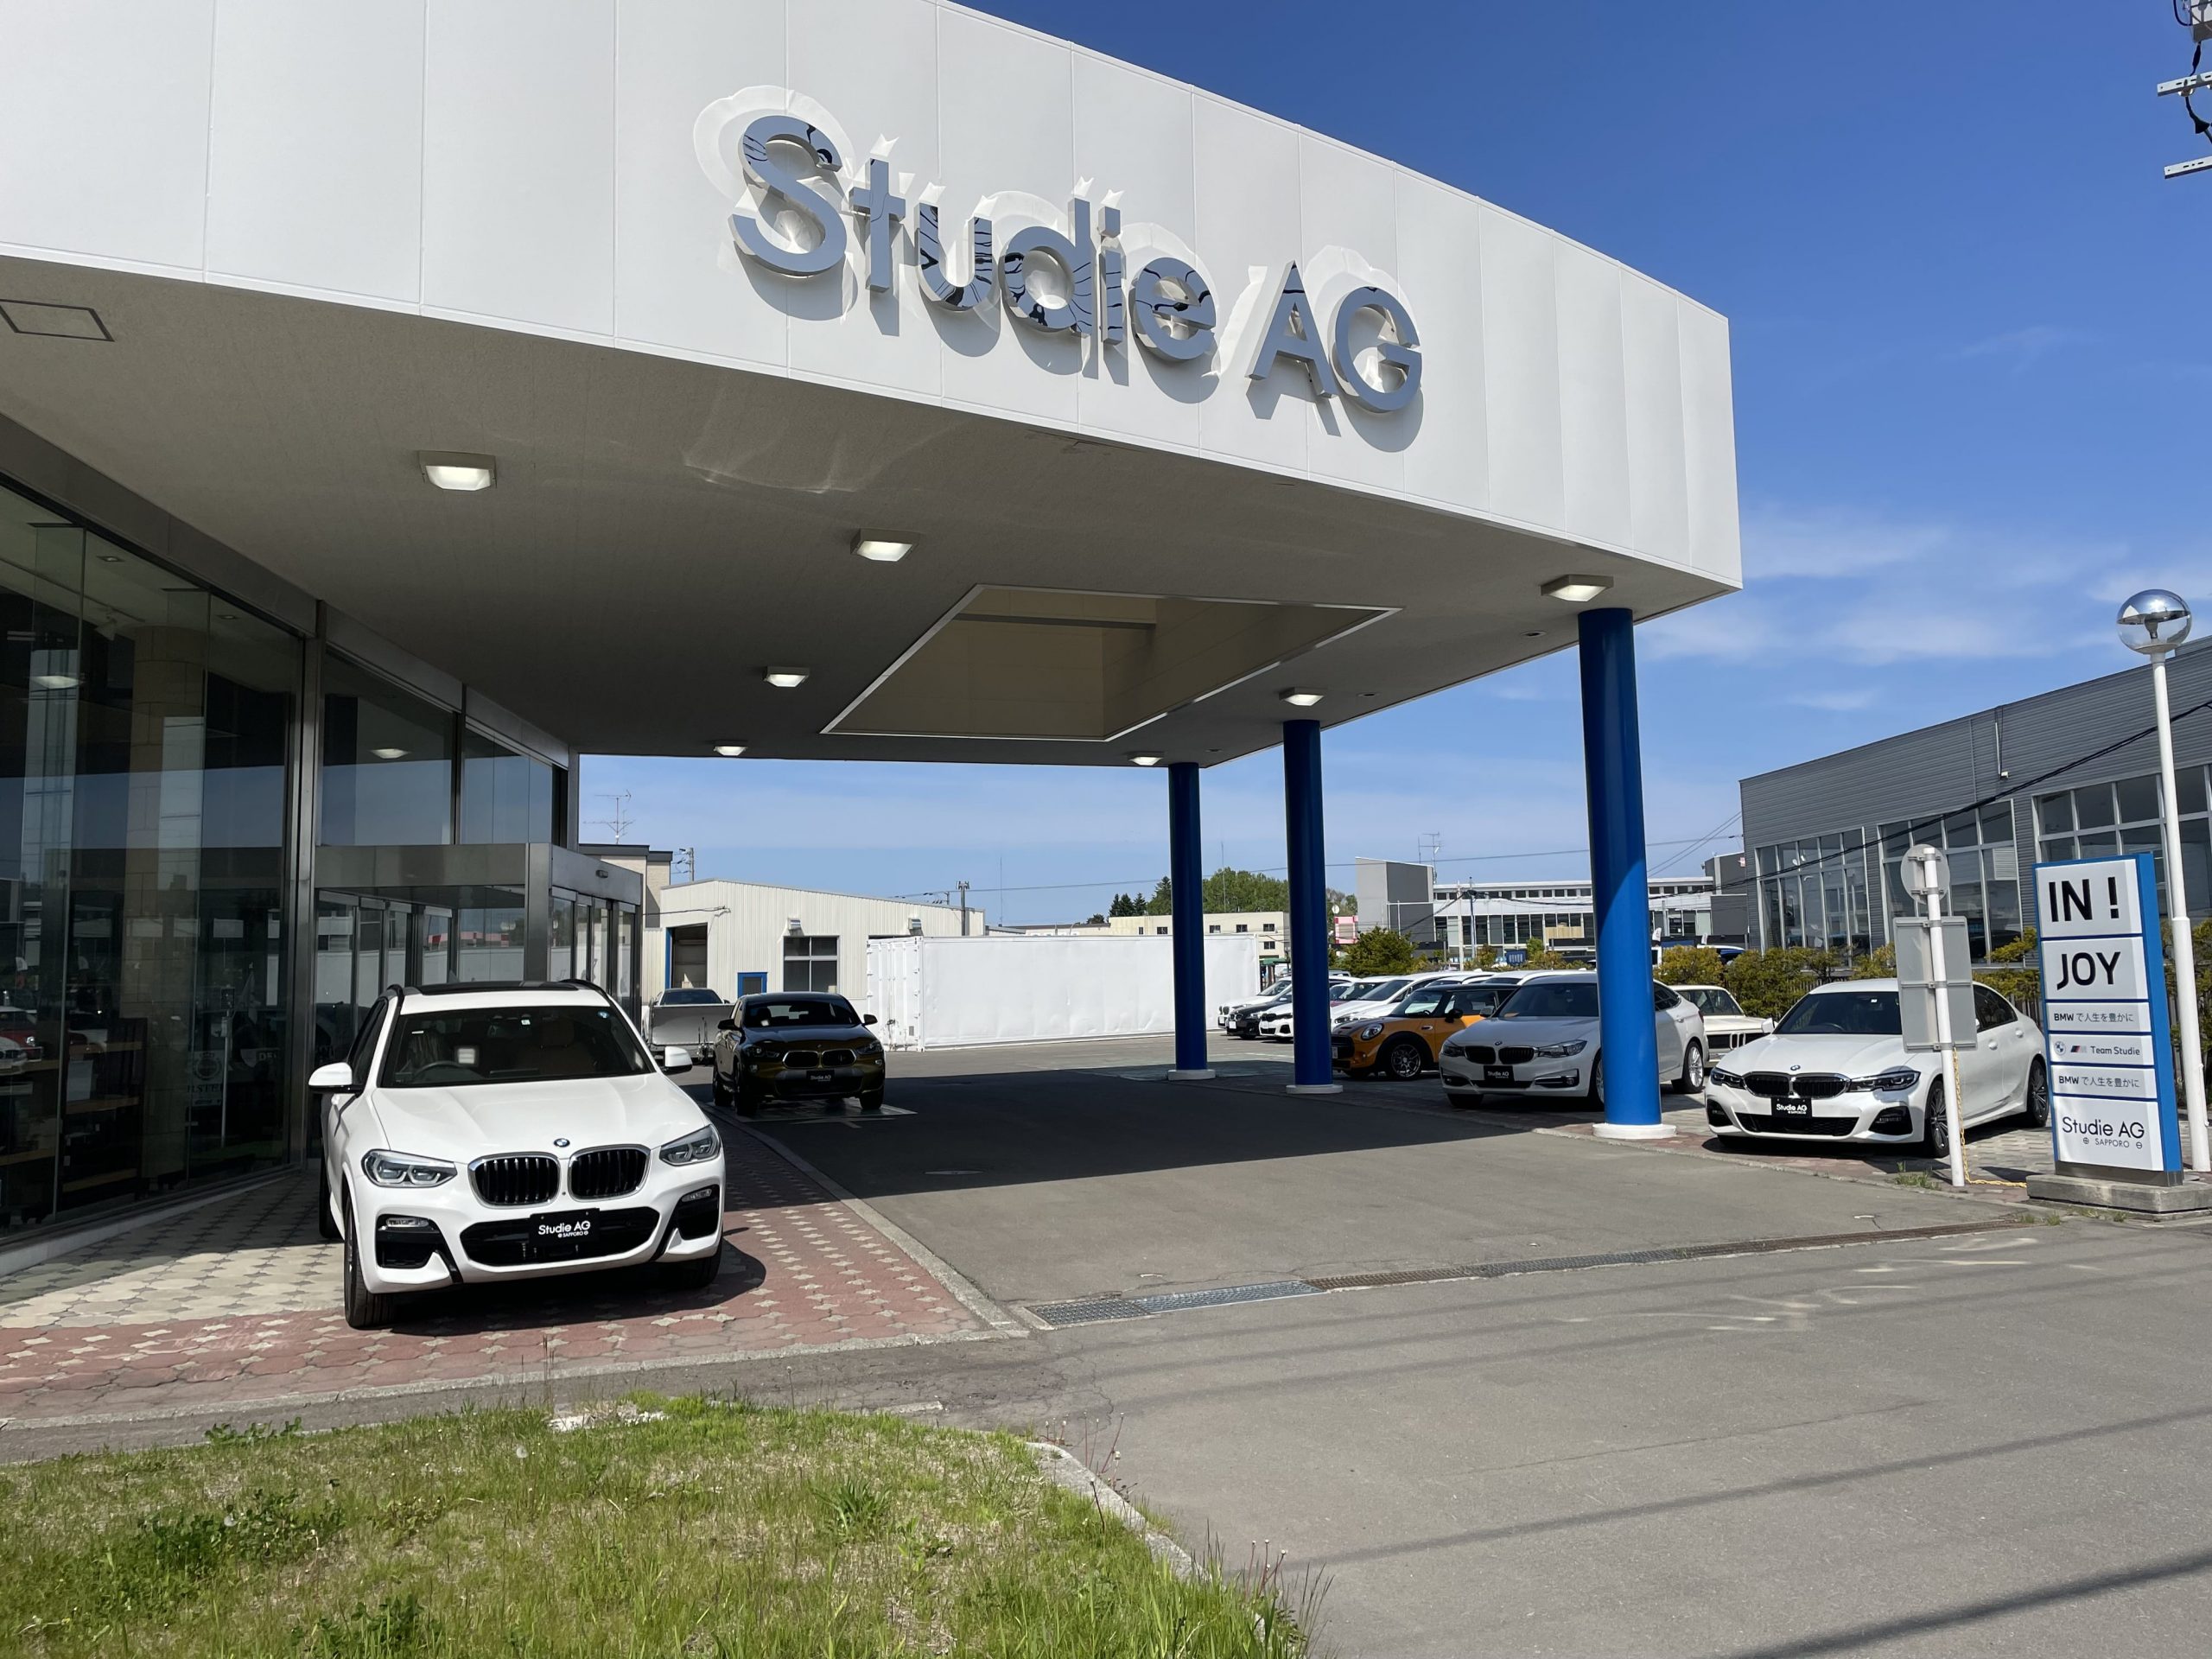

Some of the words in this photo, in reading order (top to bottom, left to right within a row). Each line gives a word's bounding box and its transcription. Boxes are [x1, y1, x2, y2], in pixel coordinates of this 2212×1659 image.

[728, 115, 1216, 361] Studie
[1249, 260, 1421, 413] AG
[2049, 879, 2093, 922] IN
[2107, 876, 2120, 919] !
[2056, 951, 2121, 990] JOY
[2054, 1013, 2075, 1021] BMW
[2076, 1013, 2133, 1022] で人生を豊かに
[2090, 1046, 2113, 1055] Team
[2113, 1046, 2140, 1056] Studie
[2058, 1076, 2079, 1084] BMW
[2081, 1077, 2139, 1087] で人生を豊かに
[2062, 1116, 2113, 1136] Studie
[2118, 1121, 2145, 1139] AG
[2094, 1137, 2130, 1148] SAPPORO
[538, 1222, 572, 1236] Studie
[573, 1220, 591, 1231] AG
